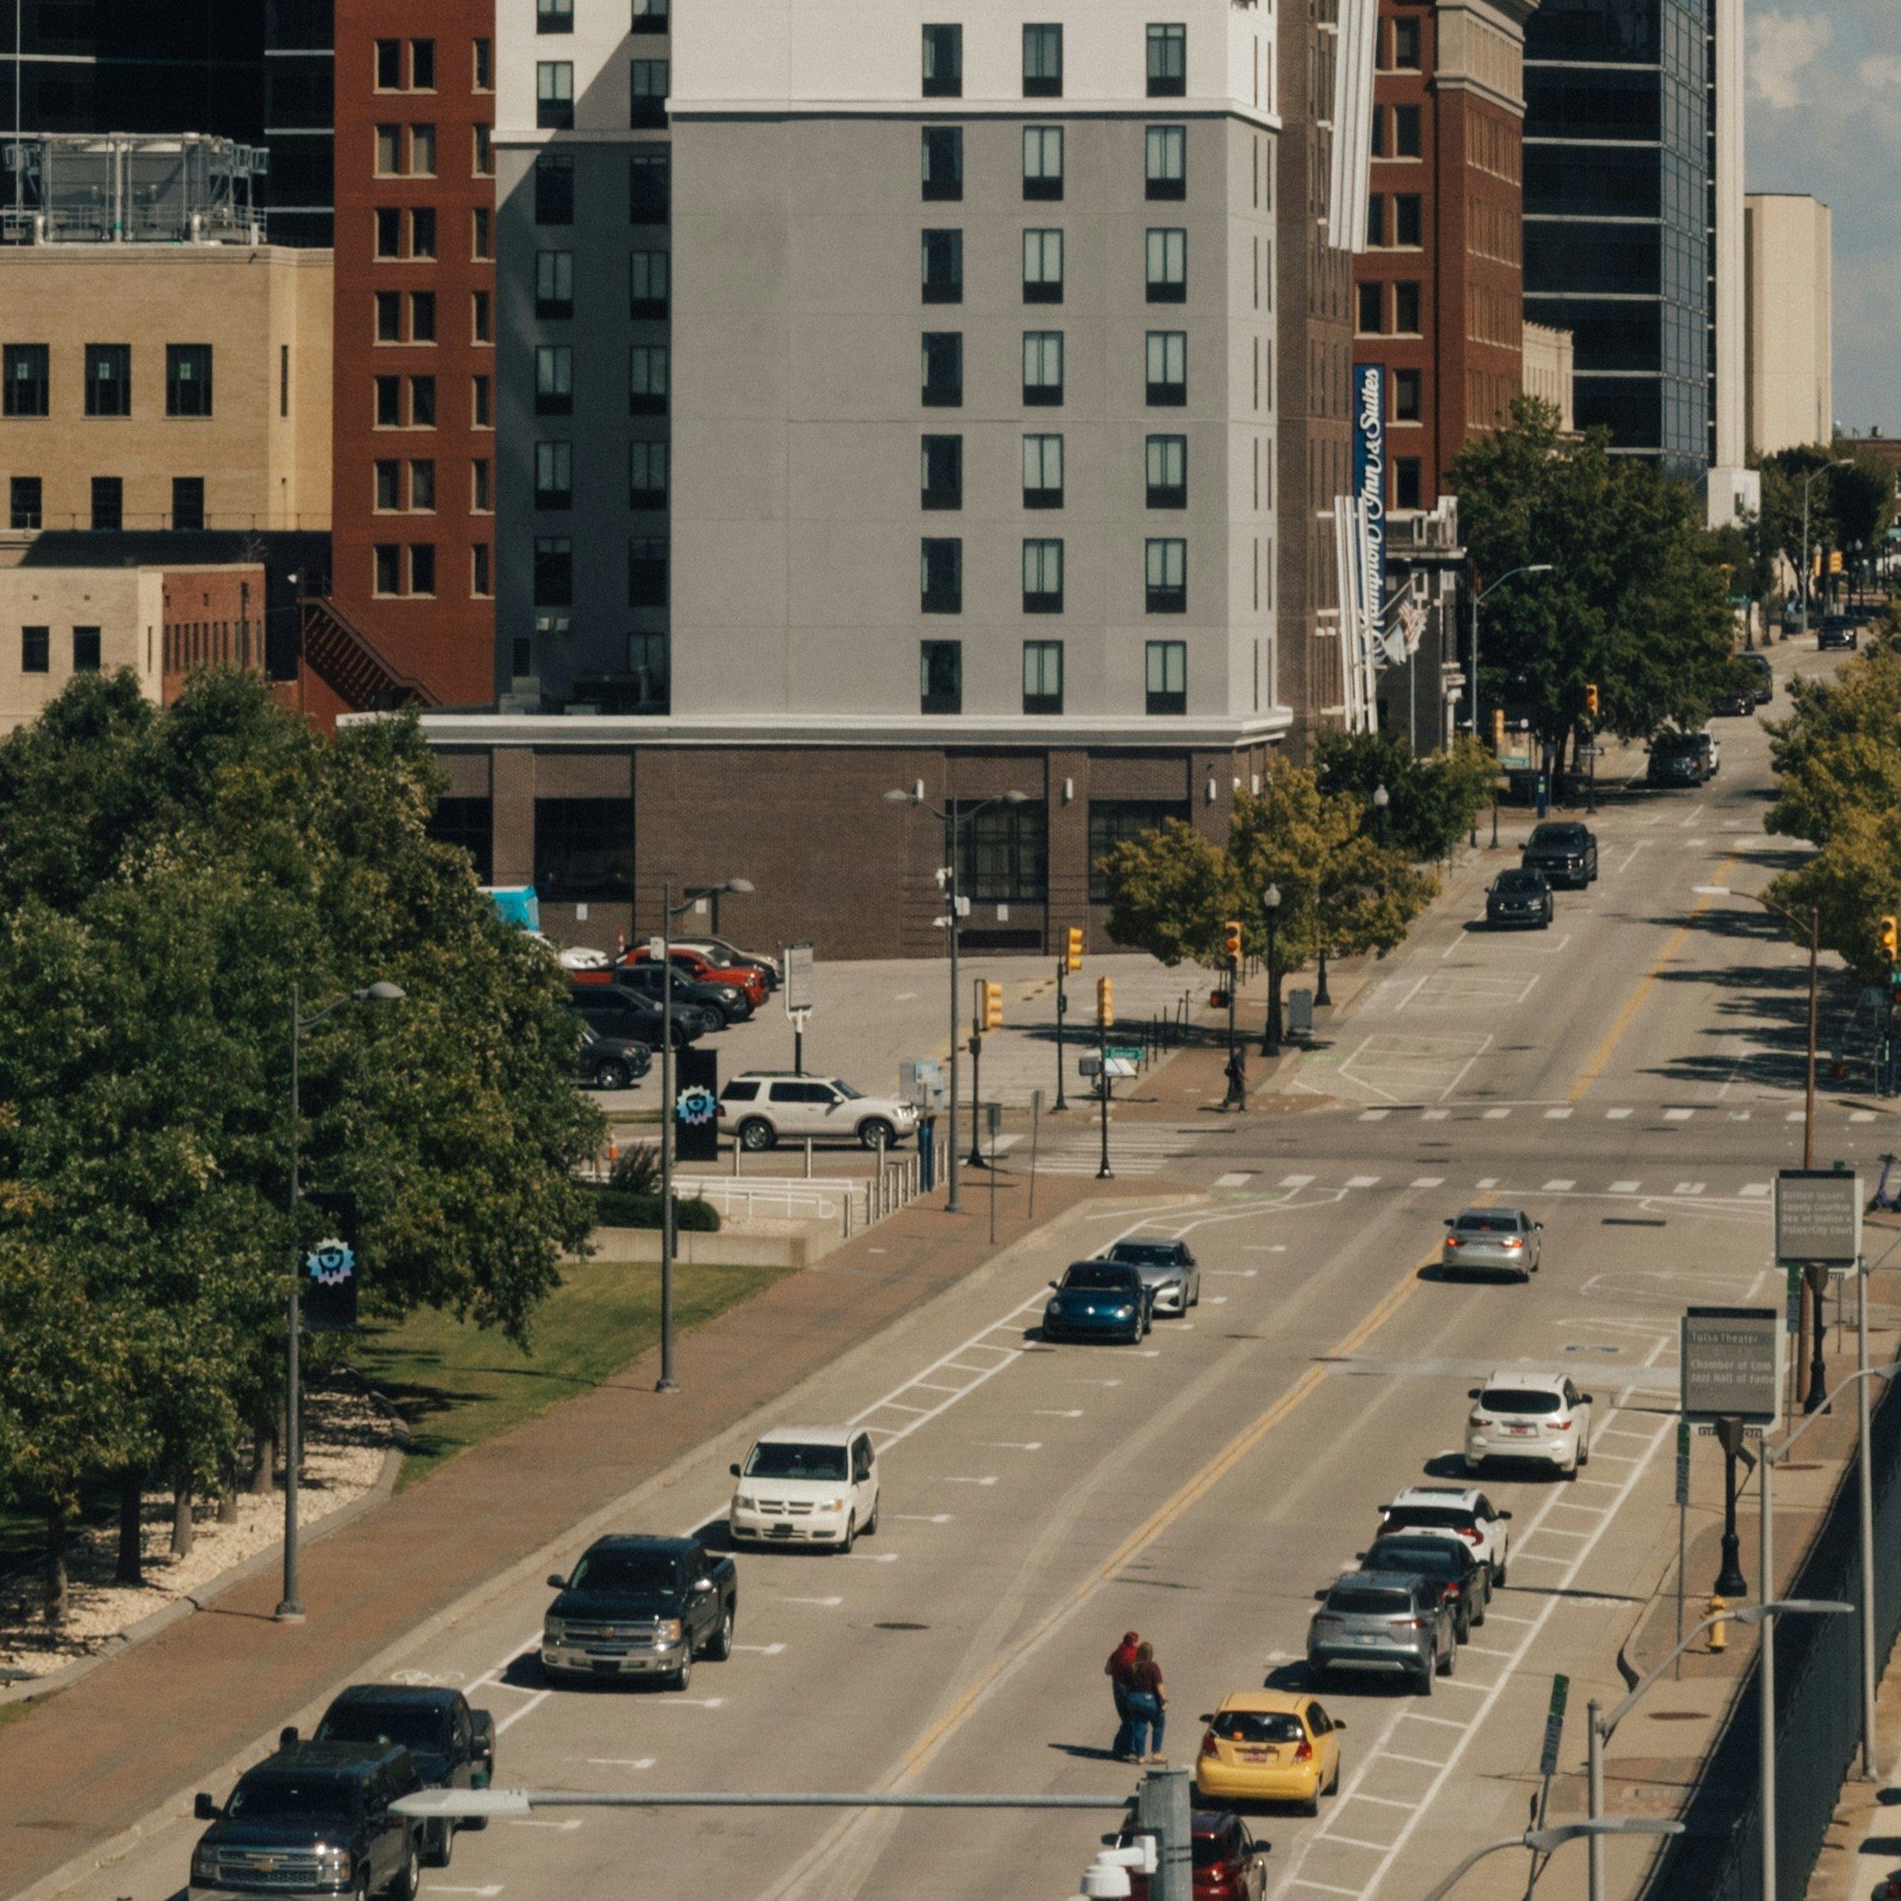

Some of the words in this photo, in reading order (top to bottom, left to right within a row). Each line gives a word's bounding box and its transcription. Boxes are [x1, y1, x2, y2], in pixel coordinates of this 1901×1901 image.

[1359, 368, 1381, 439] Suites
[1365, 436, 1383, 455] &
[1361, 454, 1383, 520] Inn
[1691, 1332, 1719, 1342] Tulsa
[1721, 1332, 1759, 1344] Theater
[1691, 1360, 1734, 1370] Chamber
[1737, 1360, 1748, 1370] of
[1691, 1373, 1710, 1383] Jazz
[1713, 1373, 1733, 1383] Hall
[1736, 1373, 1748, 1383] of
